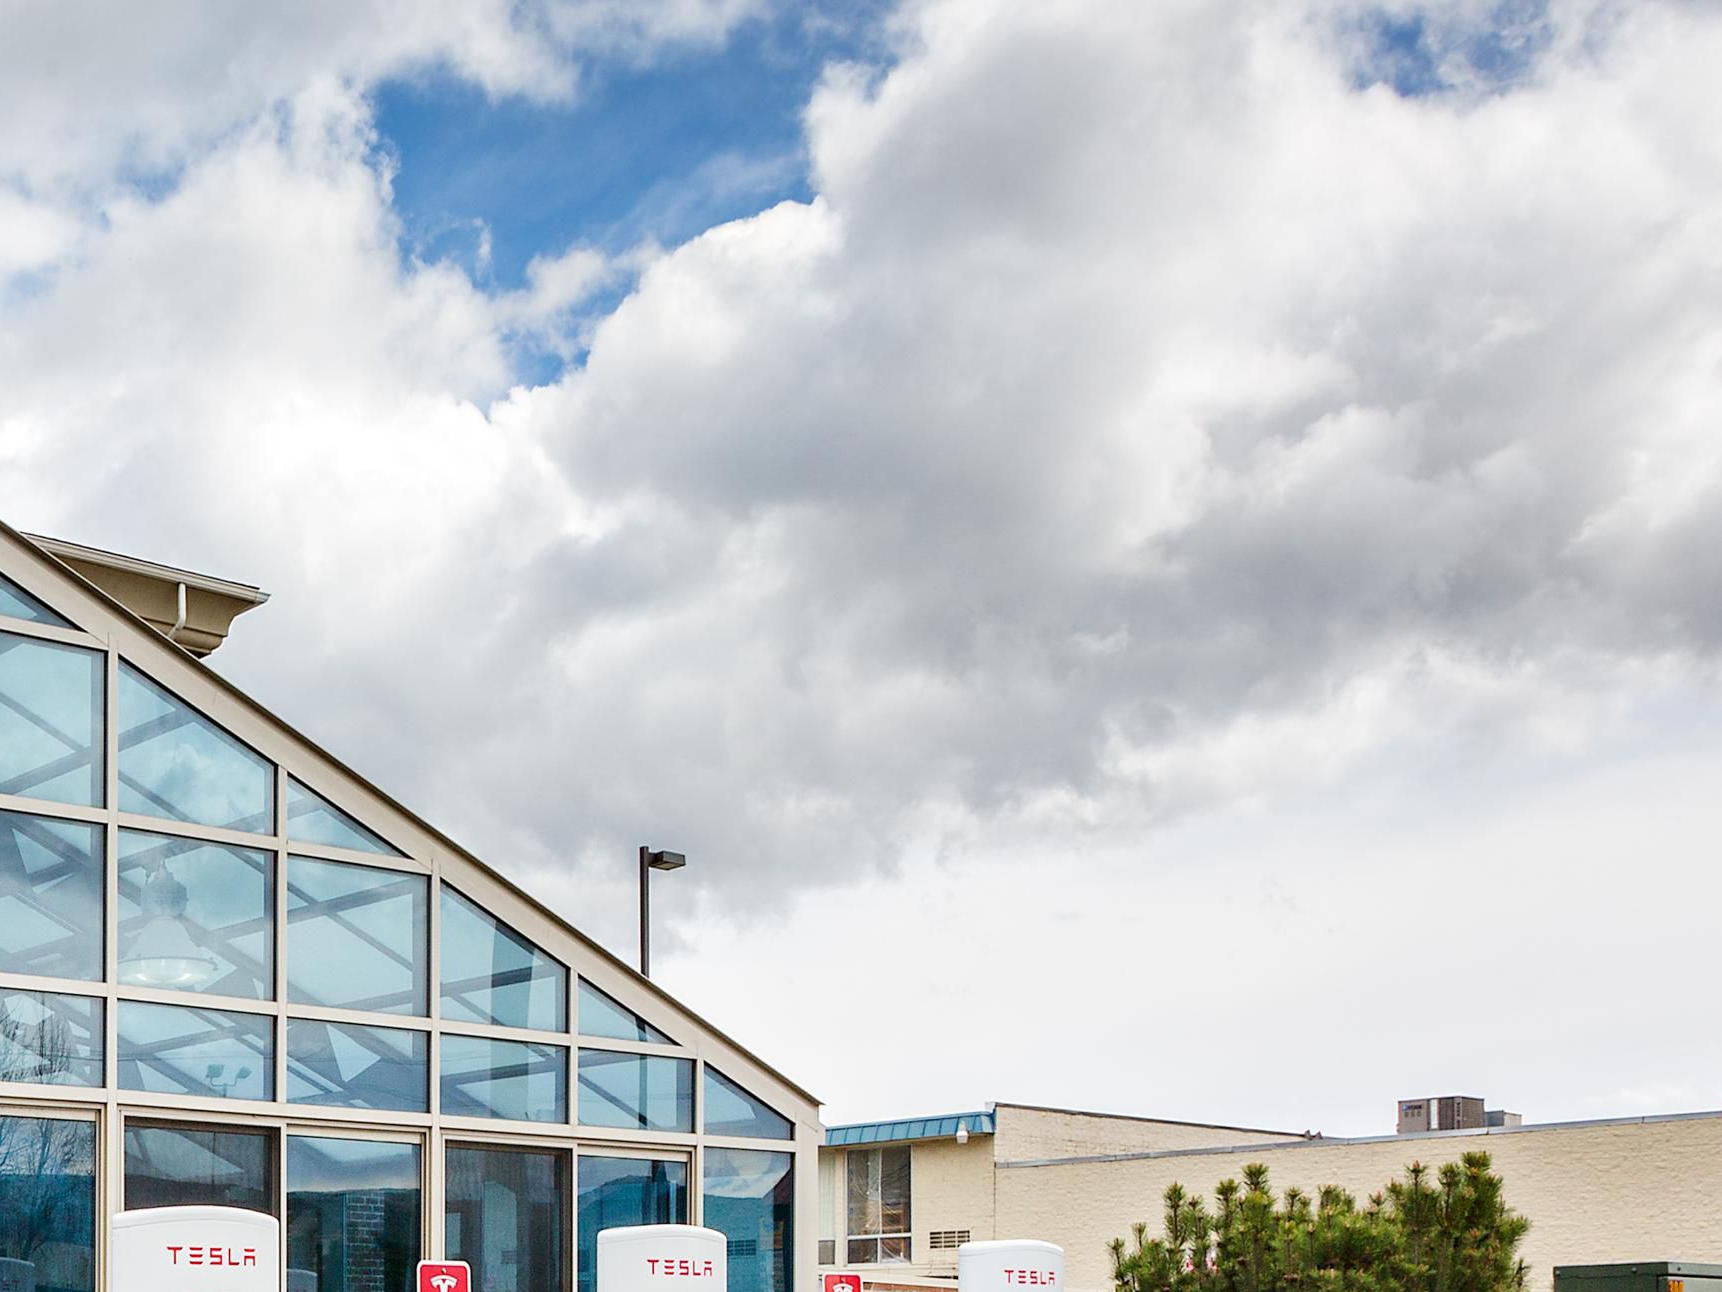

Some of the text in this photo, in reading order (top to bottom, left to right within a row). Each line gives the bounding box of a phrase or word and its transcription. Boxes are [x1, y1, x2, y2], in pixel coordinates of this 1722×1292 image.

[166, 1246, 256, 1267] TESLA
[646, 1259, 713, 1277] TESLA
[1004, 1269, 1056, 1286] TESLA
